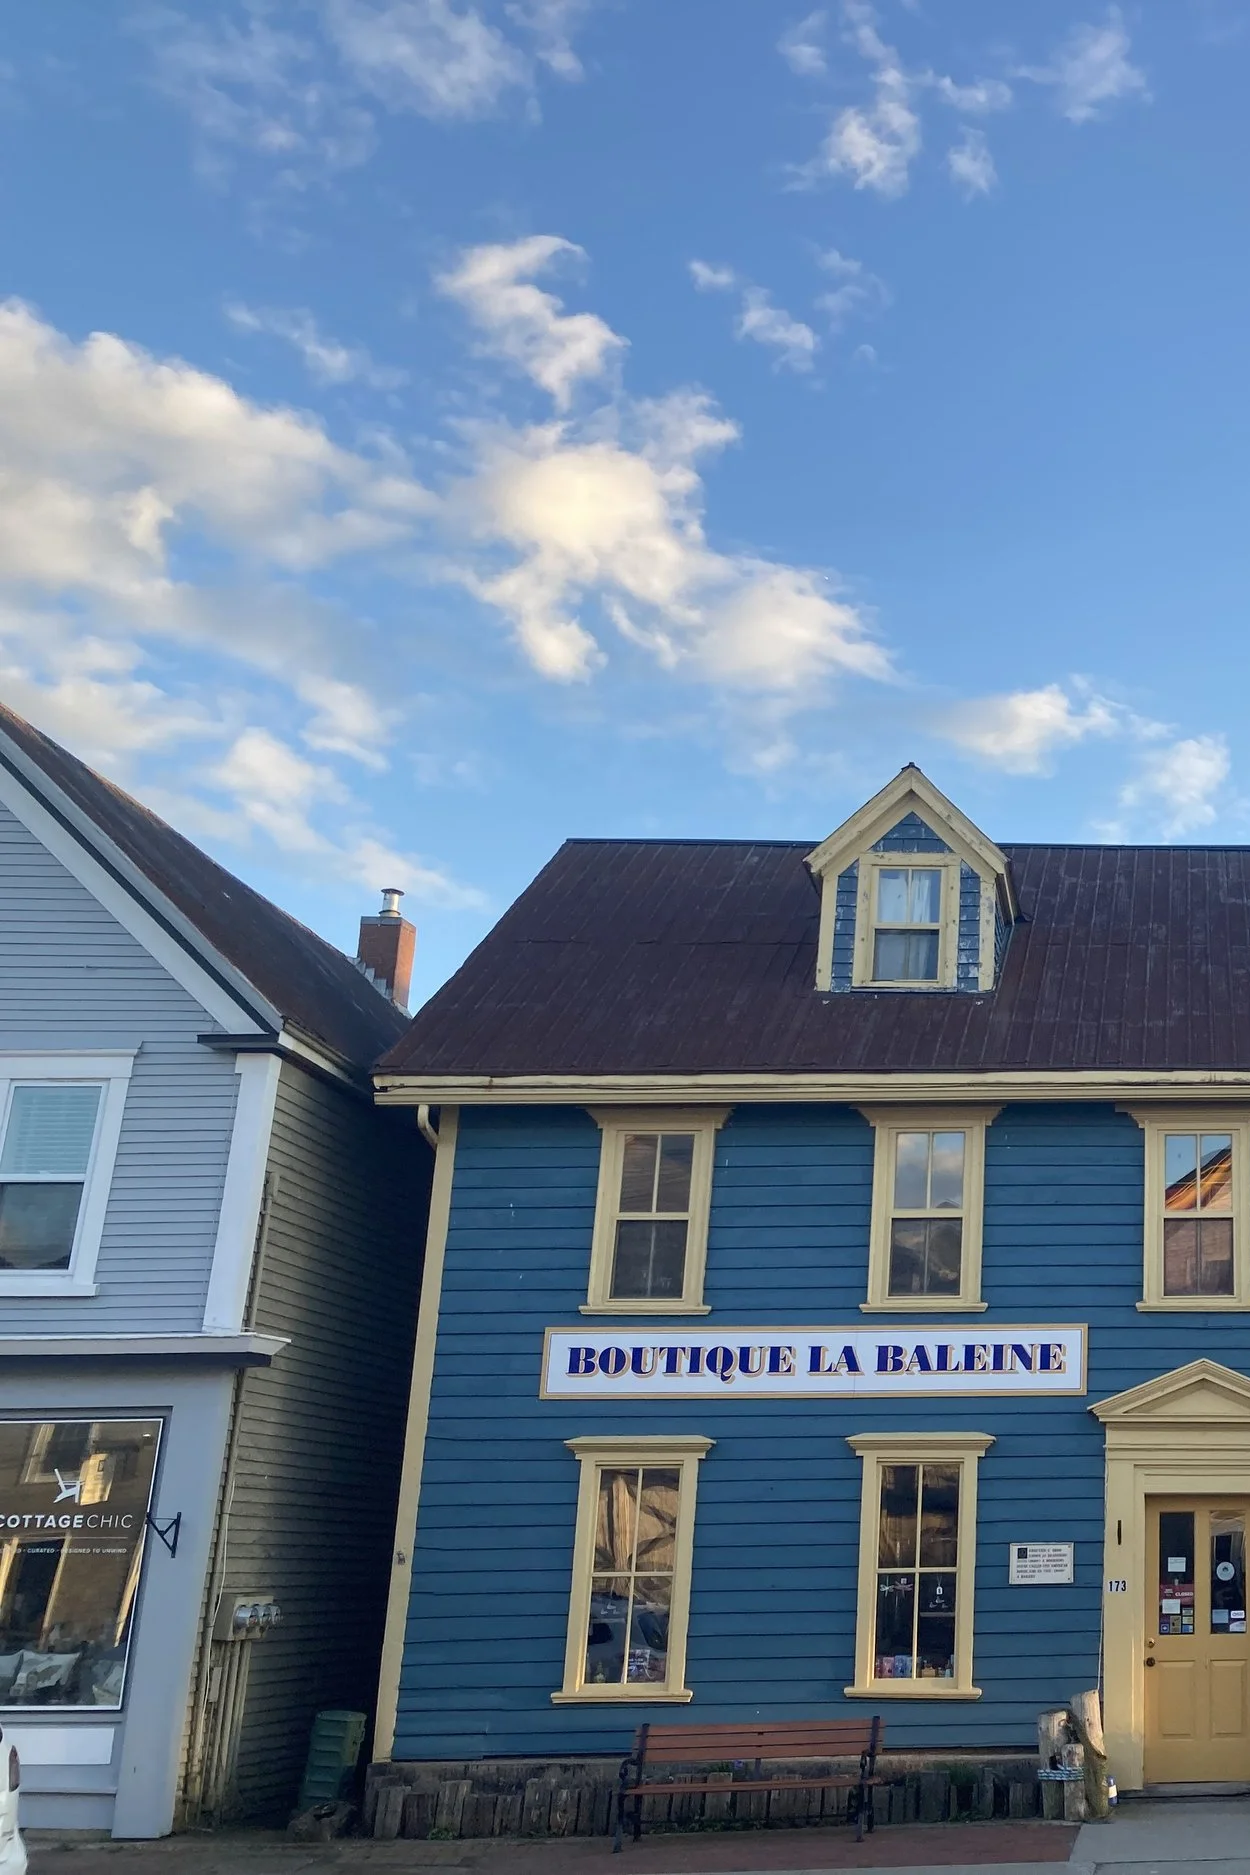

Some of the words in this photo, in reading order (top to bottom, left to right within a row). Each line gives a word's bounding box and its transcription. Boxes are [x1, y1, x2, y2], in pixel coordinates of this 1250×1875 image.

[567, 1345, 797, 1383] BOUTIQUE
[807, 1344, 863, 1375] LA
[874, 1343, 1066, 1376] BALEINE
[1108, 1580, 1127, 1592] 173
